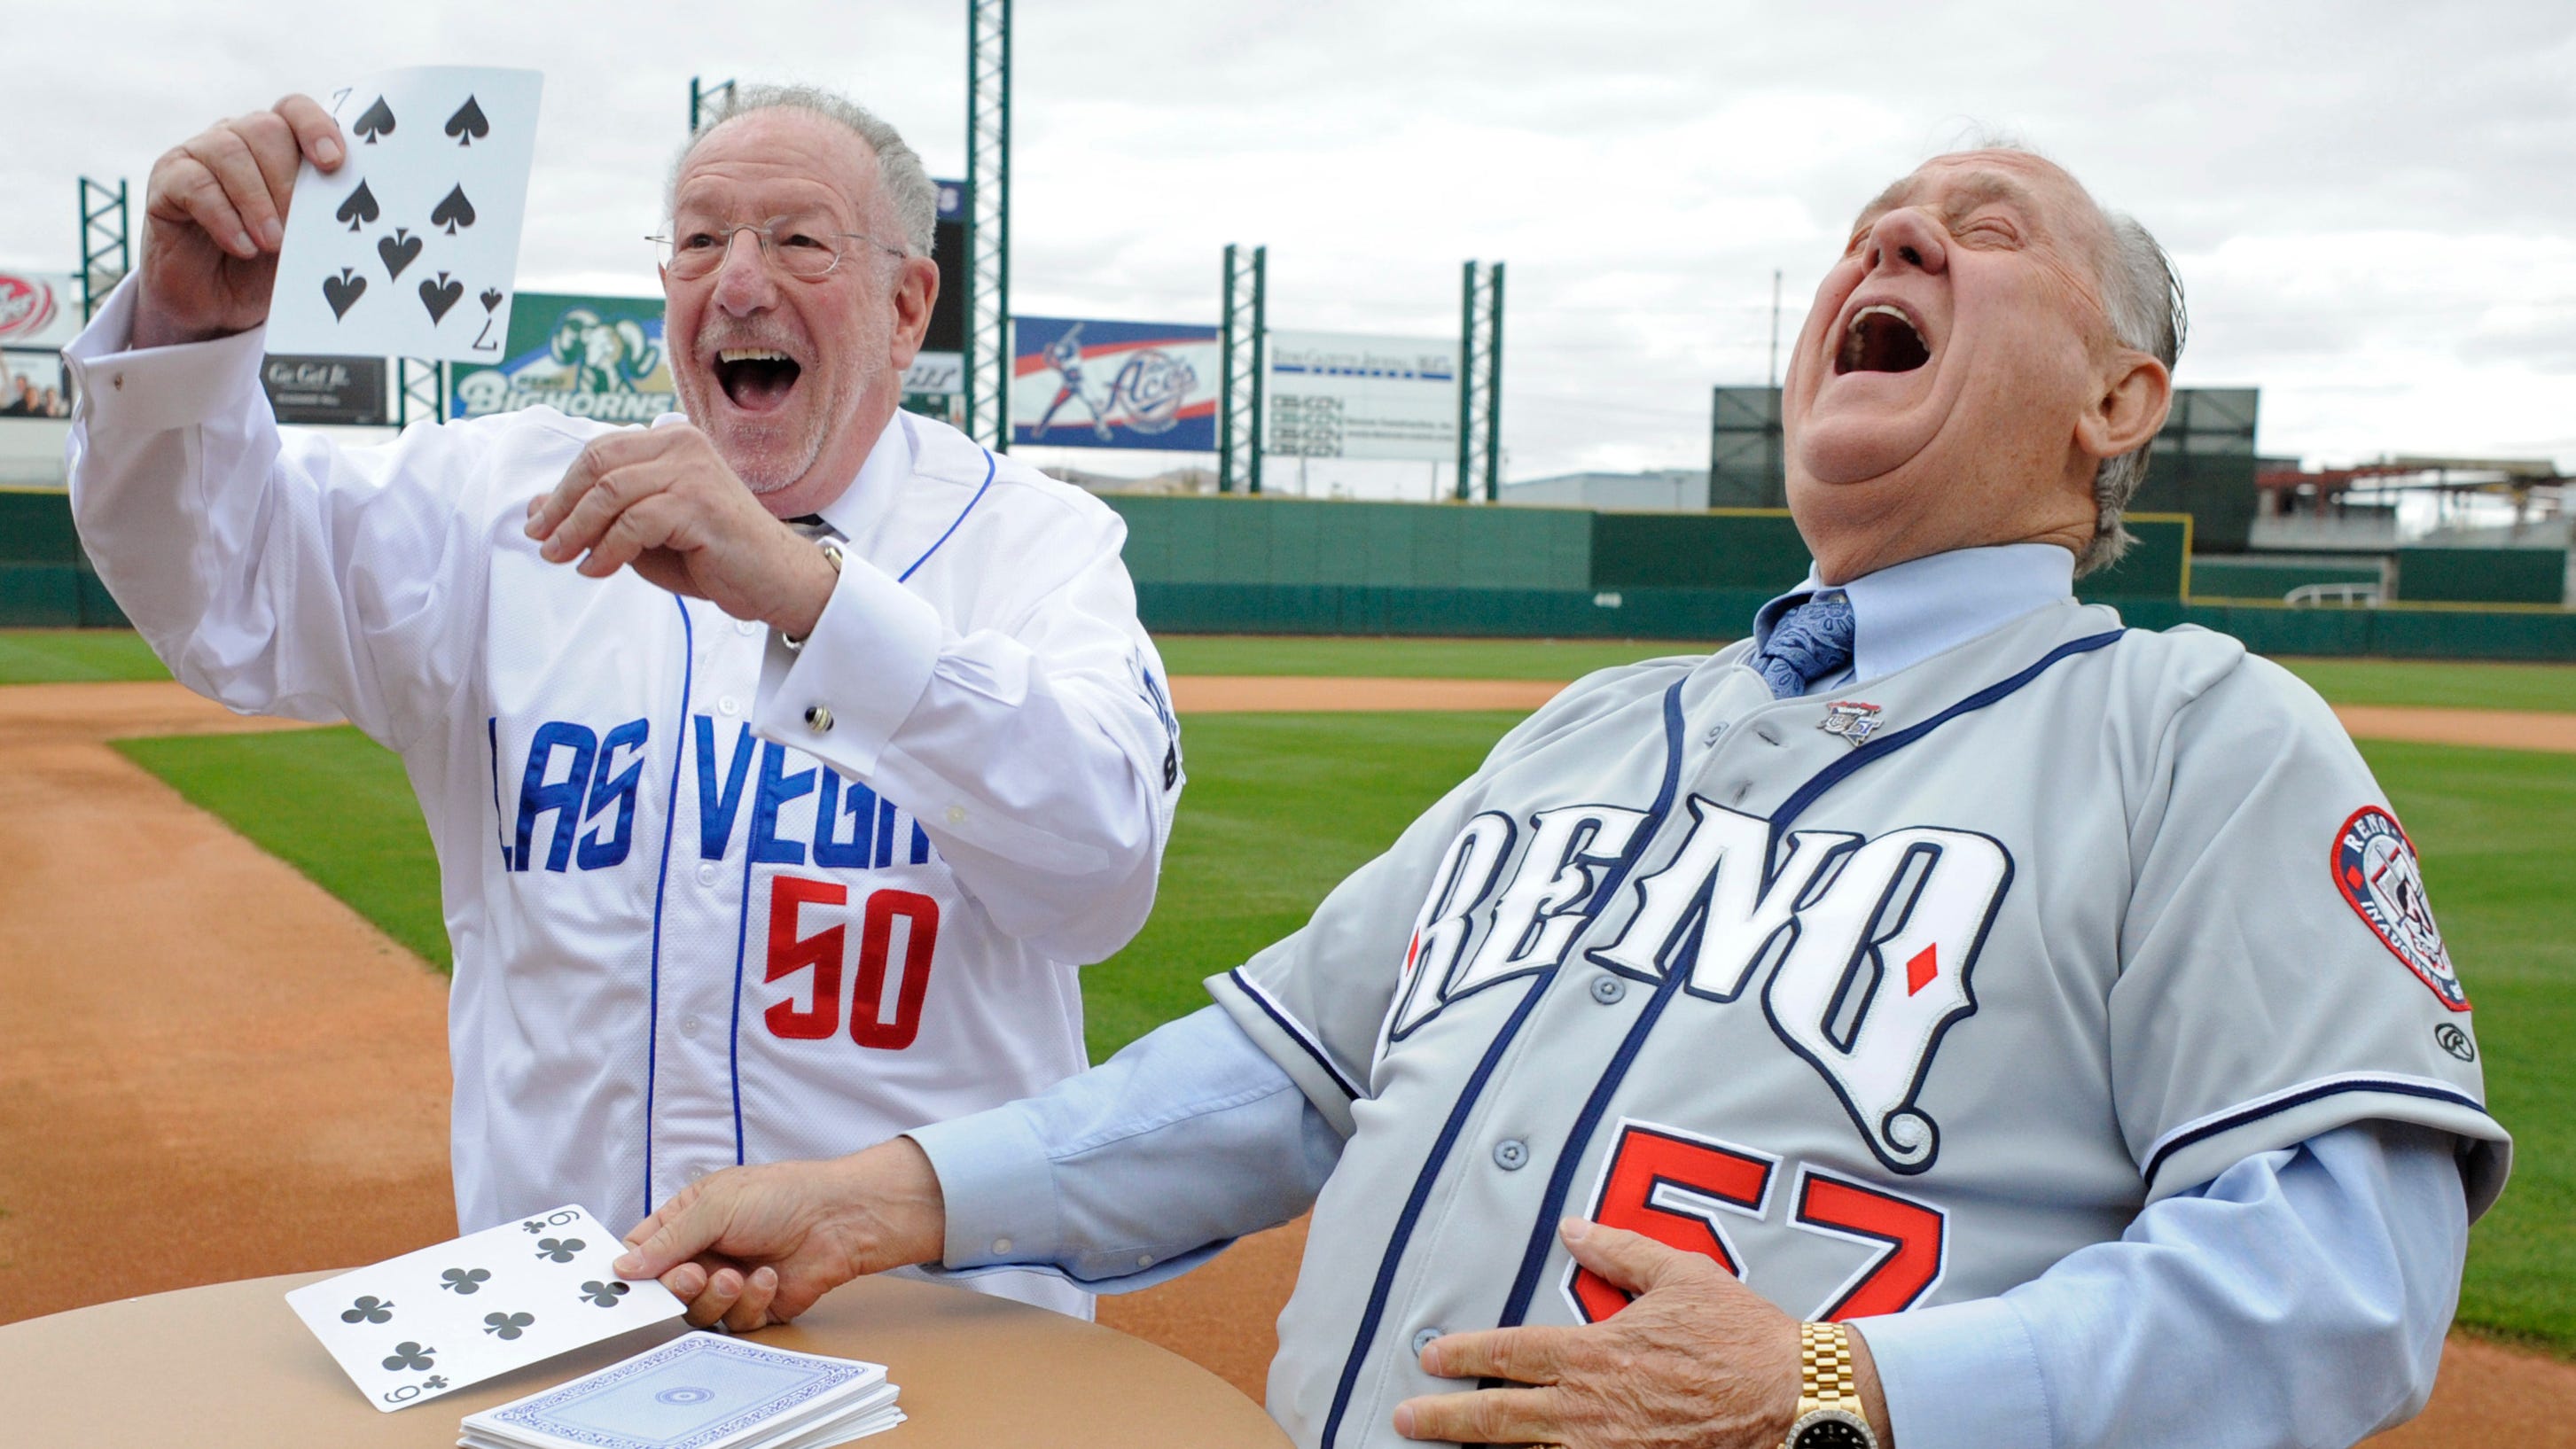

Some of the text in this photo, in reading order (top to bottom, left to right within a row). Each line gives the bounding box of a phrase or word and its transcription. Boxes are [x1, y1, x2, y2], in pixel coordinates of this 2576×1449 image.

[472, 318, 498, 351] 7
[457, 370, 675, 421] BIGHORNS
[488, 715, 944, 873] LAS VEG
[2344, 813, 2388, 853] RENO
[764, 876, 940, 1050] 50
[1370, 793, 2015, 1175] RENO
[548, 1211, 580, 1226] 6
[1559, 1117, 1949, 1324] 57
[384, 1385, 421, 1403] 6
